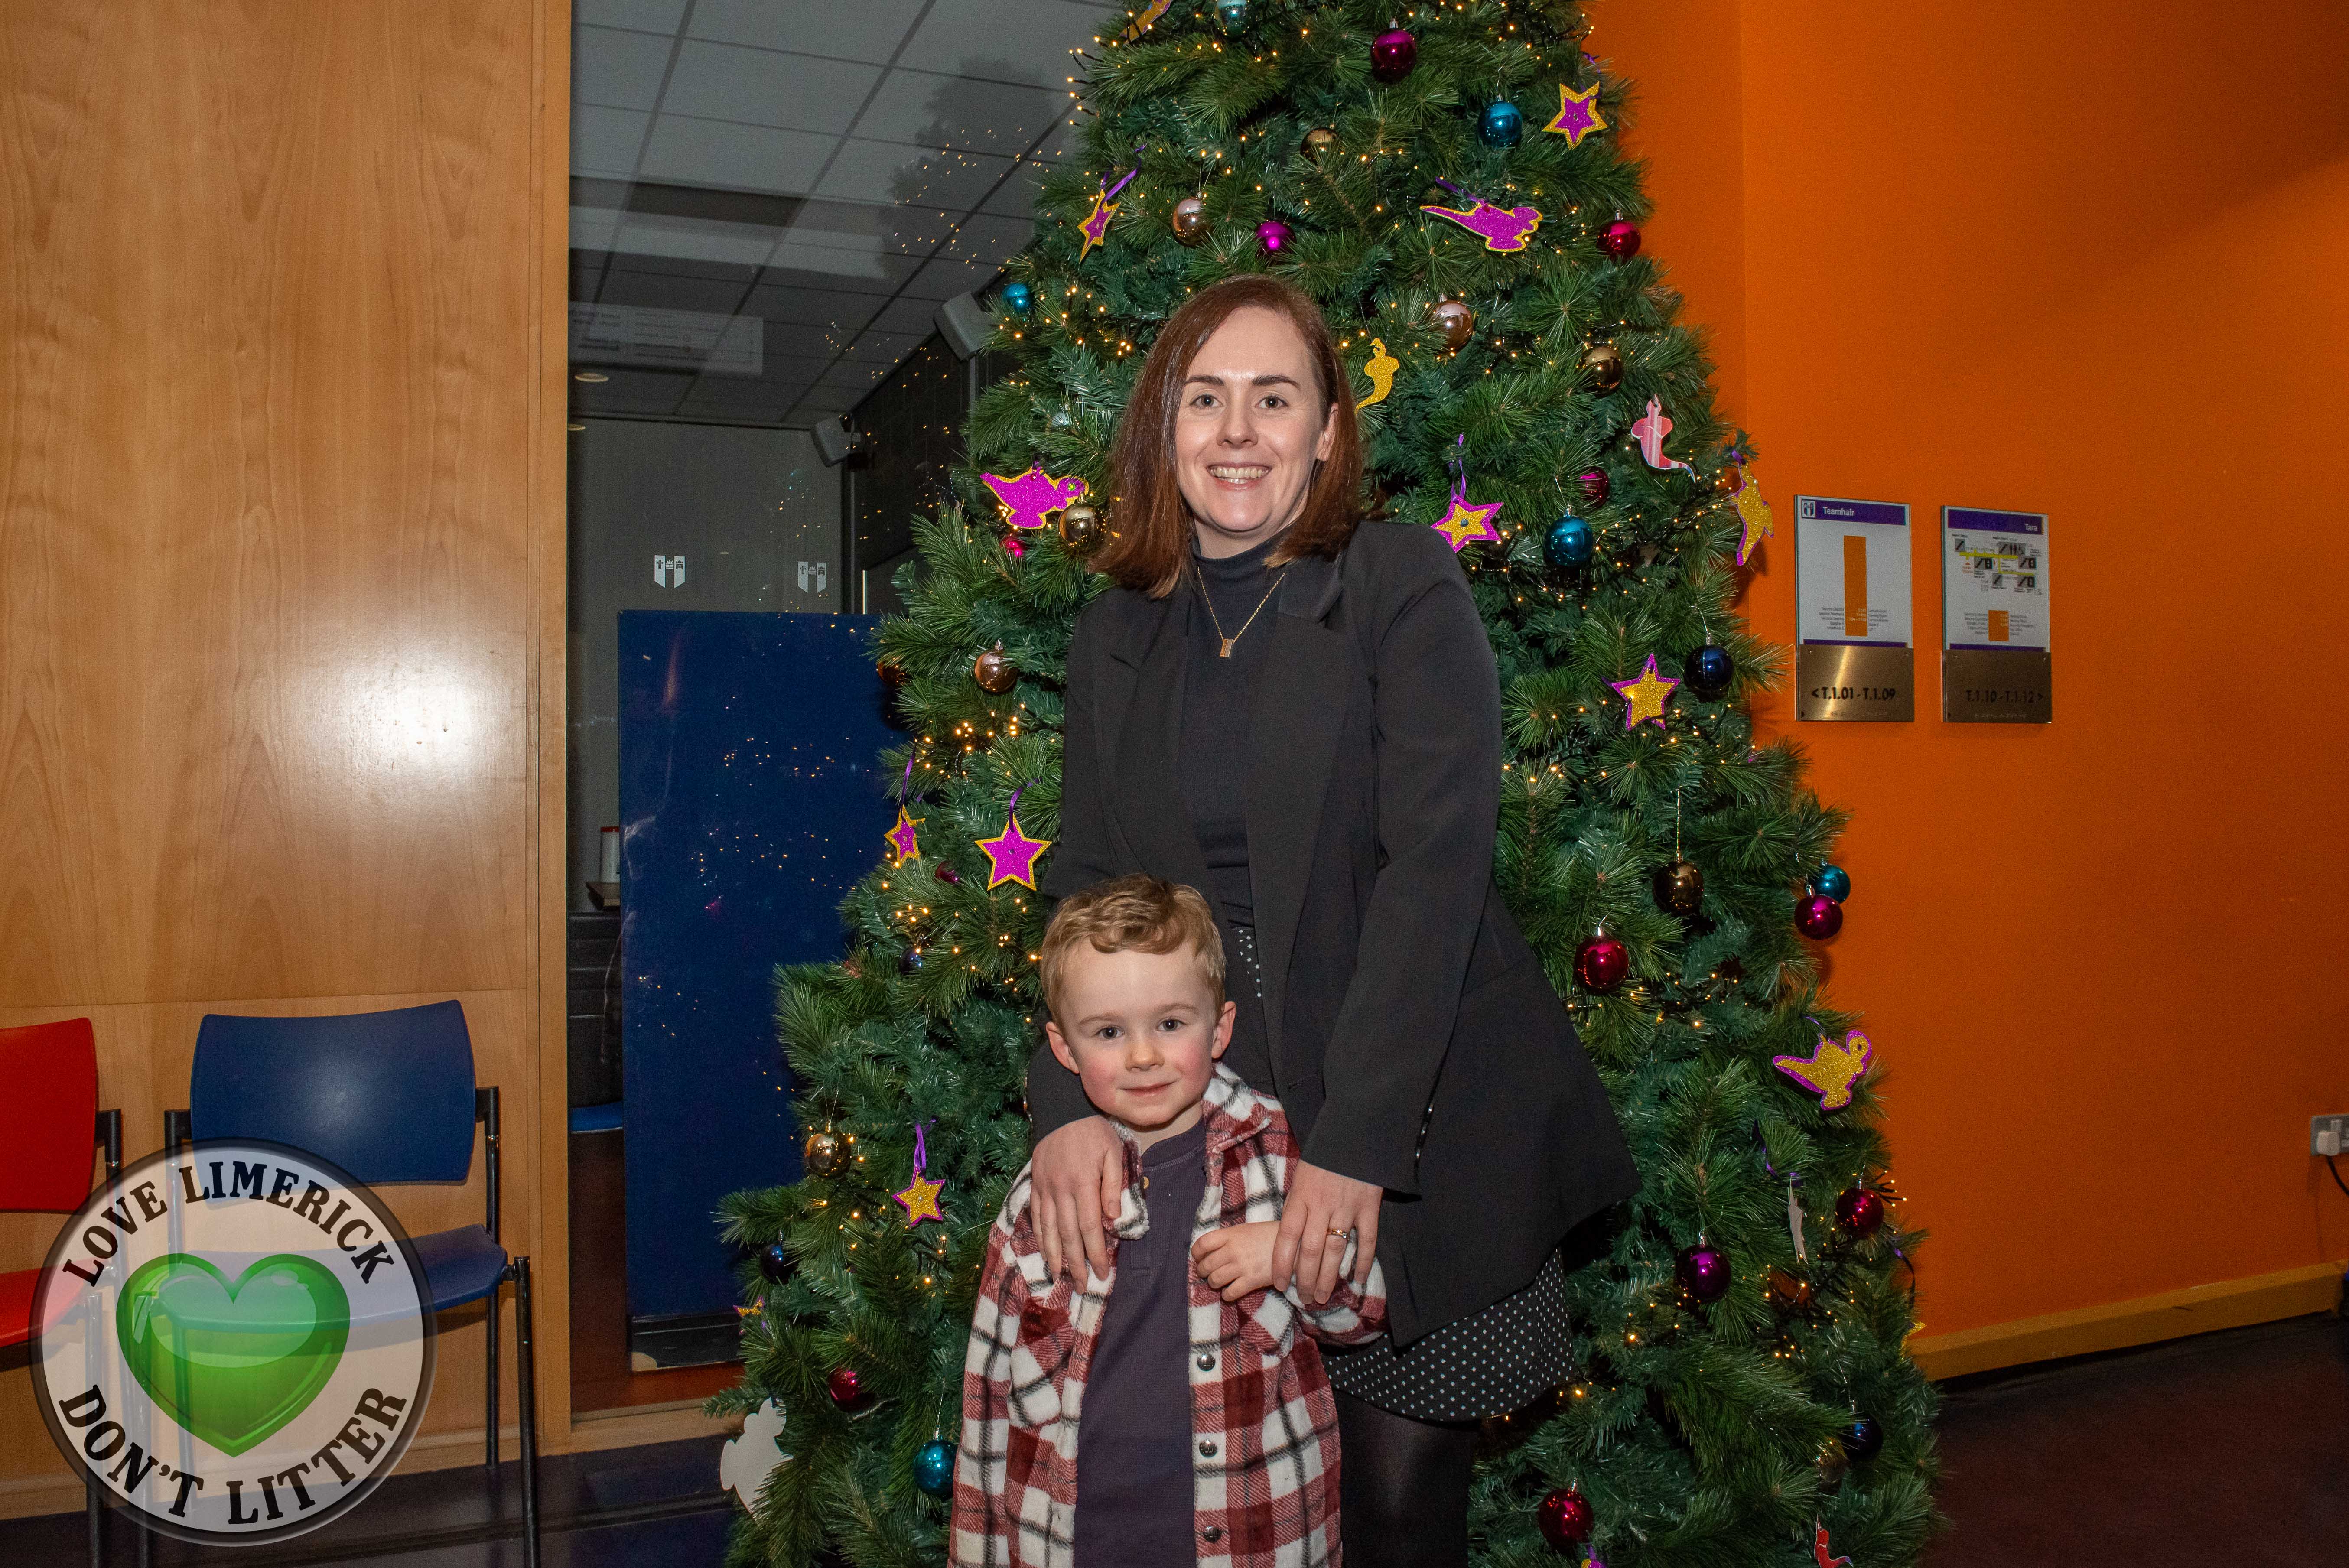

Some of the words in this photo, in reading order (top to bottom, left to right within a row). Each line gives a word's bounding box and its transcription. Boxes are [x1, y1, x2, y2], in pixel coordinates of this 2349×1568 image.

[1822, 506, 1855, 516] Teamhair
[2024, 523, 2038, 531] Tara
[1821, 686, 1854, 700] T.1.01
[1863, 687, 1896, 701] T.1.09
[1965, 690, 1998, 703] T.1.10
[2006, 690, 2034, 703] T.1.12
